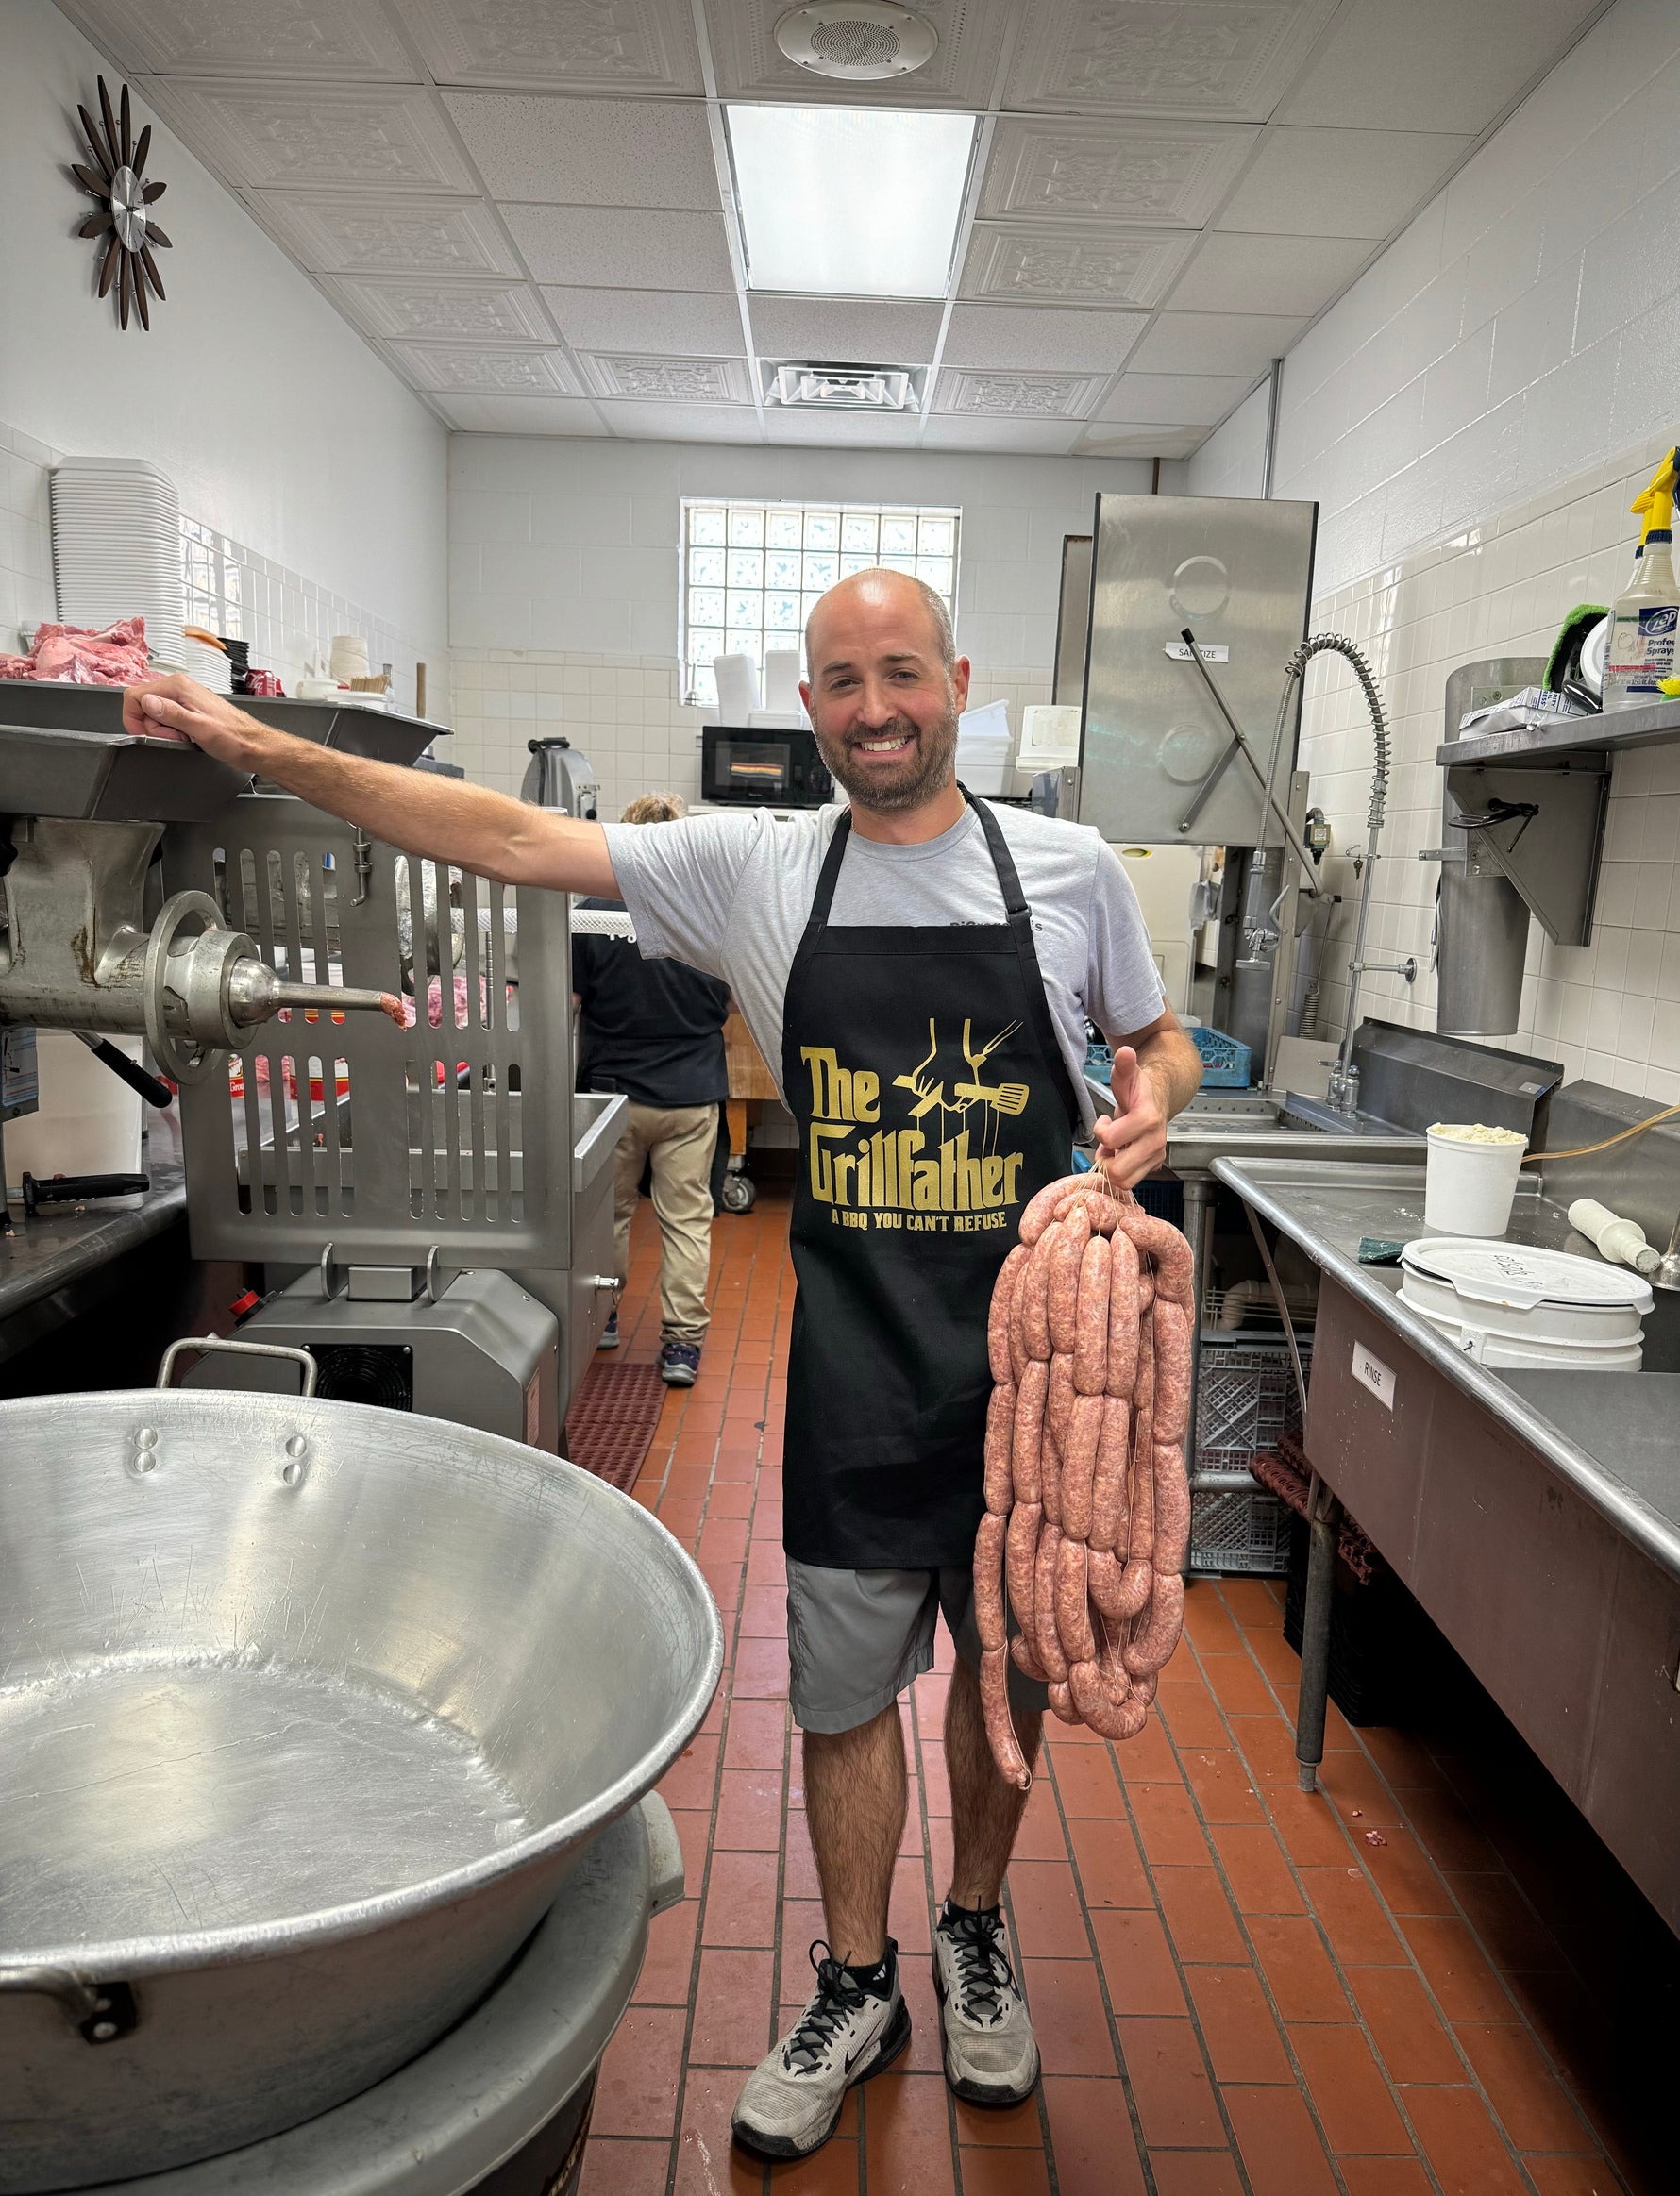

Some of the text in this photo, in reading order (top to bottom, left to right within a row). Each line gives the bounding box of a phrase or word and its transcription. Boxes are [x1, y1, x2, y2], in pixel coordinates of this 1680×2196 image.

[1179, 648, 1216, 659] SATIZE
[800, 1046, 881, 1123] The
[811, 1121, 1024, 1211] Grillfather
[832, 1209, 1007, 1232] A BBQ YOU CAN'T REFUSE
[1364, 1361, 1382, 1387] RINSE
